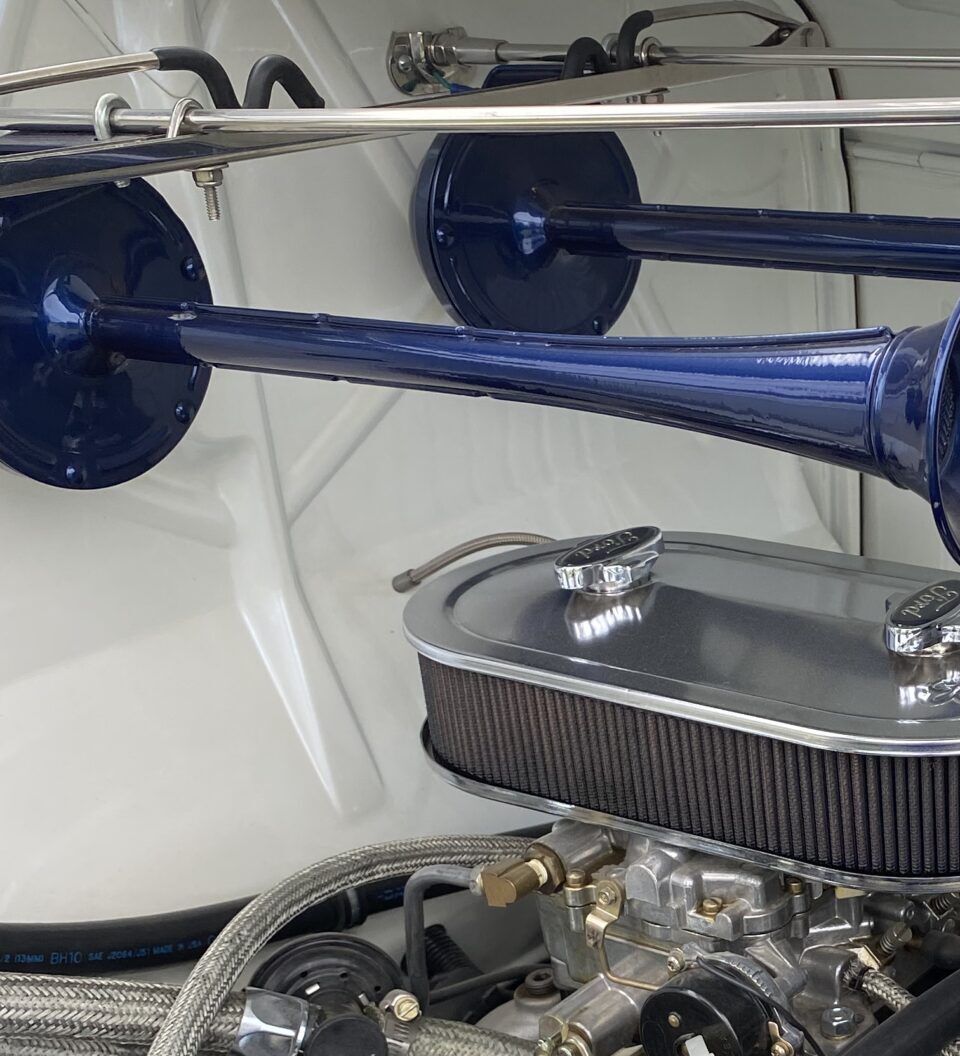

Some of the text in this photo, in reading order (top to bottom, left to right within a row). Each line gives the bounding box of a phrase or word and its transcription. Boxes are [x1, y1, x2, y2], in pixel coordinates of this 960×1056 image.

[574, 531, 639, 559] Ford
[903, 585, 959, 618] Ford
[50, 951, 83, 964] BH10
